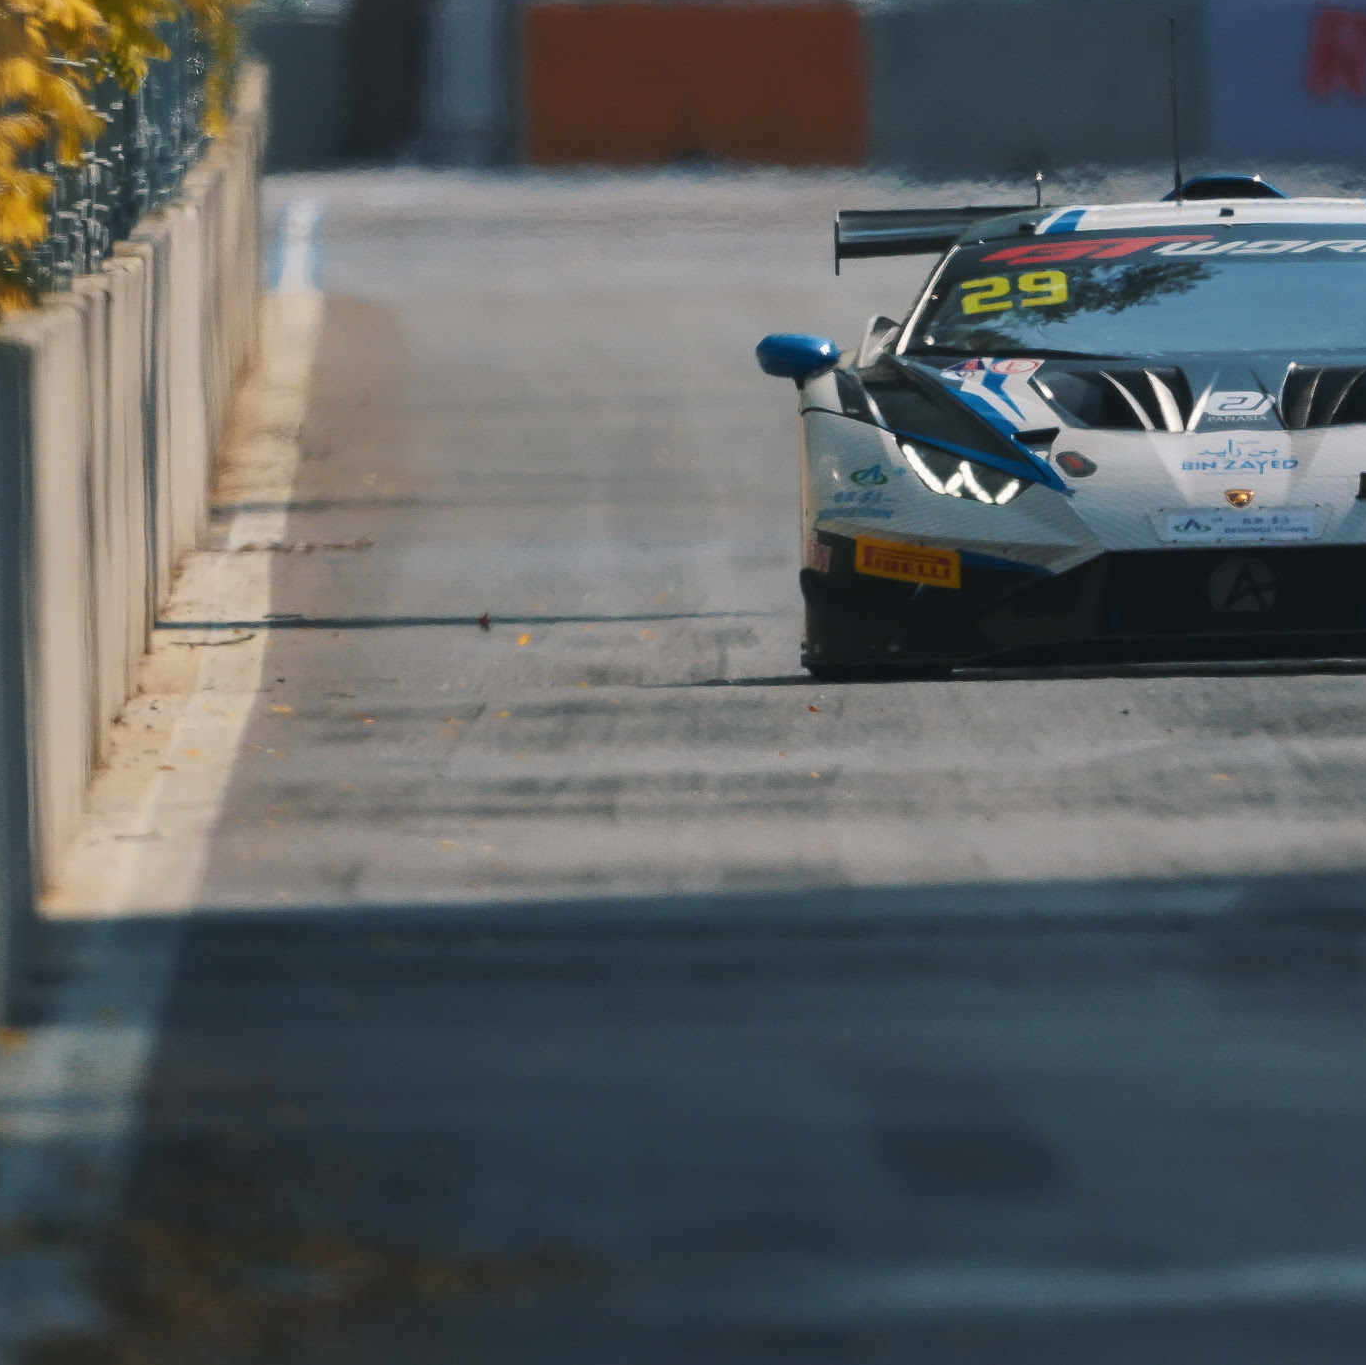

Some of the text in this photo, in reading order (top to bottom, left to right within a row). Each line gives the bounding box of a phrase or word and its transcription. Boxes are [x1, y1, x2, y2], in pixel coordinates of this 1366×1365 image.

[960, 270, 1069, 316] 29
[1207, 414, 1269, 423] PANASIA
[1181, 459, 1299, 475] BIN ZAYED
[863, 544, 952, 581] PIRELLI
